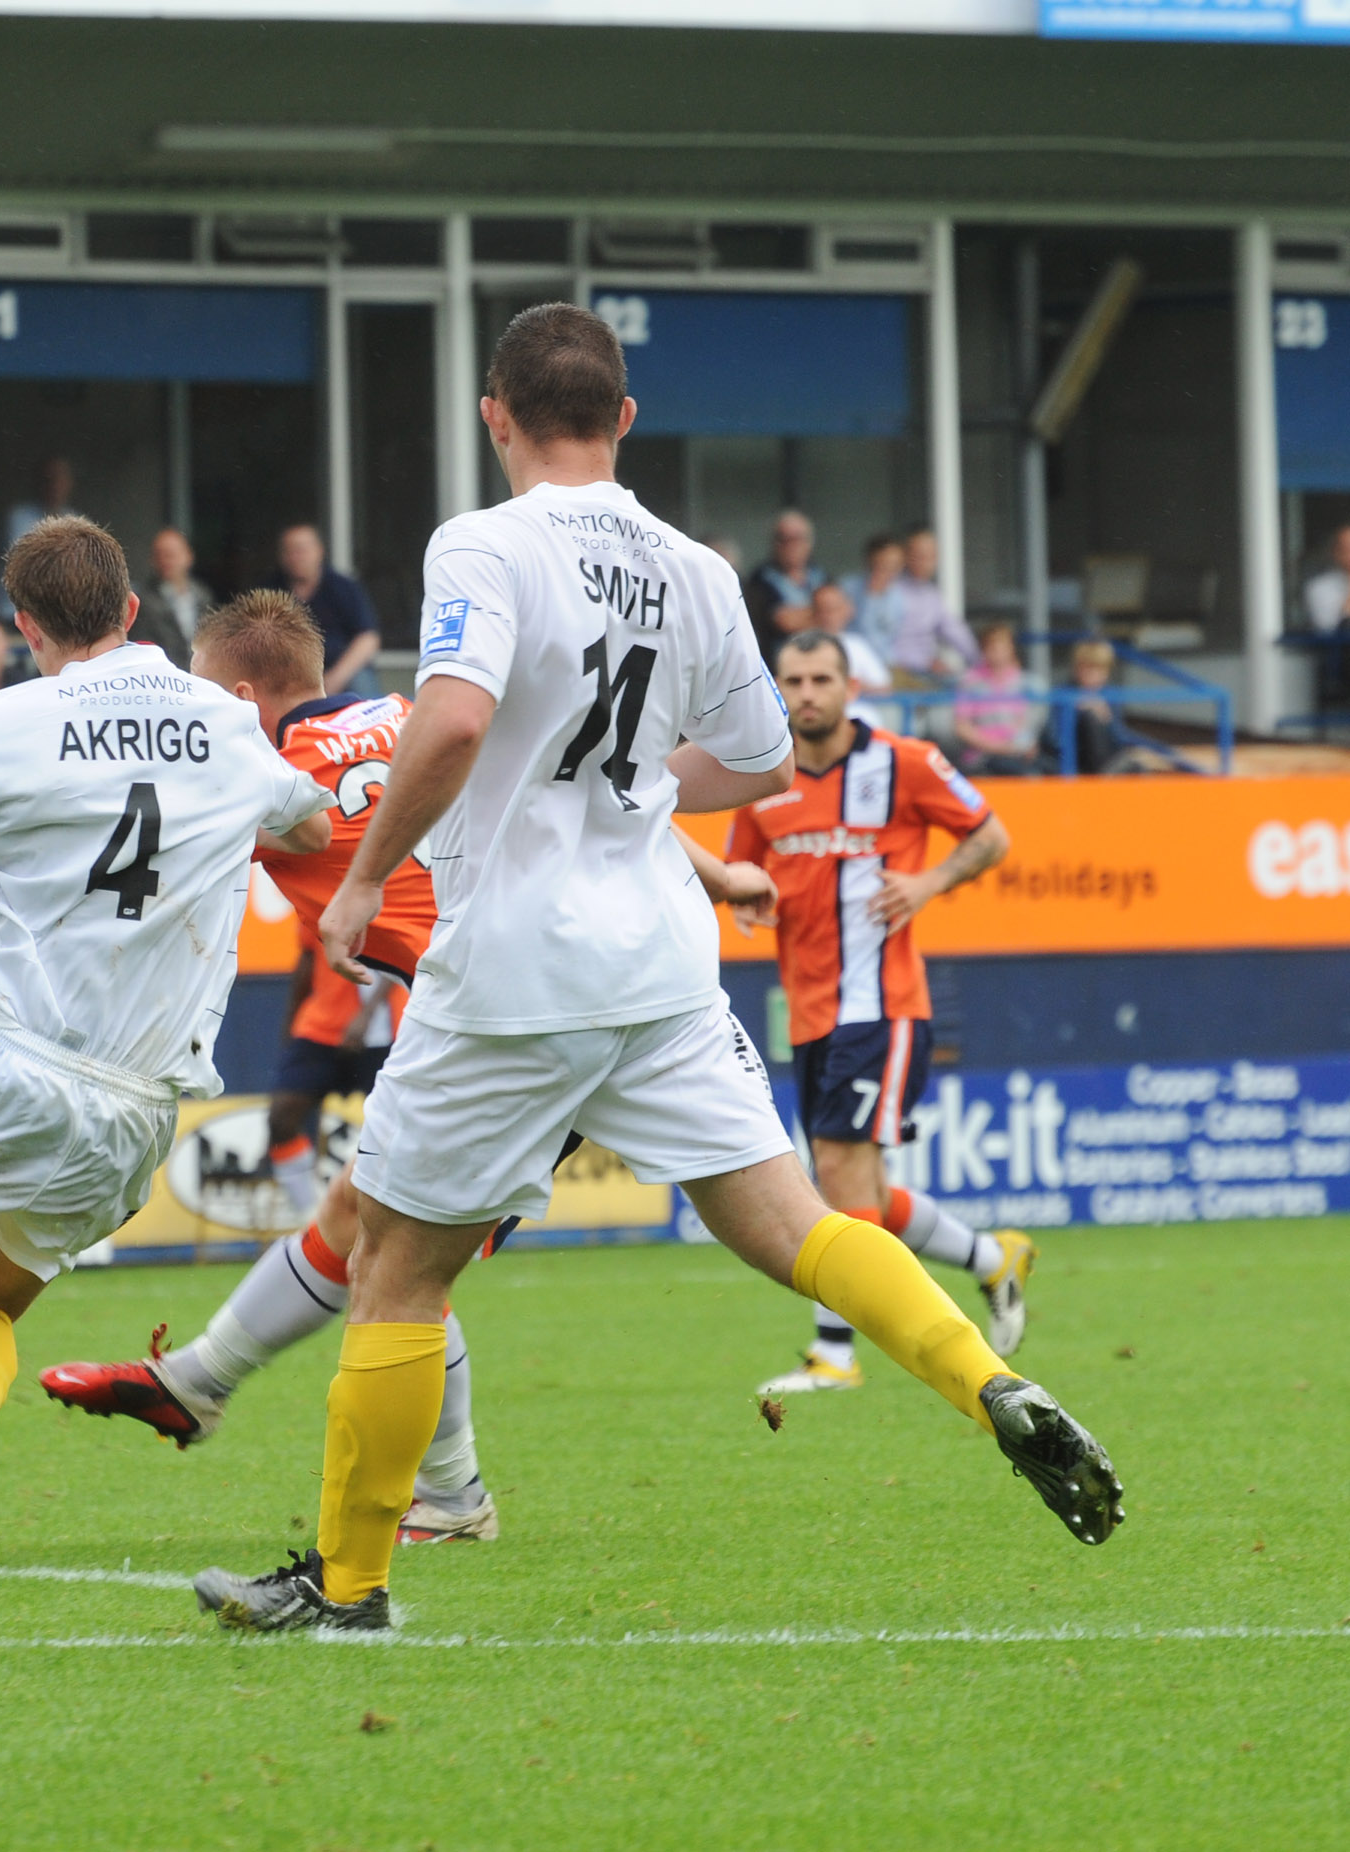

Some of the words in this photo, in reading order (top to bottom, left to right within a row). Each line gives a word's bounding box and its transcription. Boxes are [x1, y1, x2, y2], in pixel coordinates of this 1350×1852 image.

[595, 294, 650, 345] 22
[1276, 300, 1327, 348] 23
[547, 511, 674, 551] NATIONWDE
[58, 675, 197, 699] NATIONWIDE
[80, 695, 153, 707] PRODUCE
[160, 695, 185, 706] PLC
[58, 718, 210, 764] AKRIGG
[85, 783, 161, 921] 4
[1248, 820, 1350, 899] ea
[996, 861, 1158, 909] Holidays
[852, 1078, 881, 1130] 7
